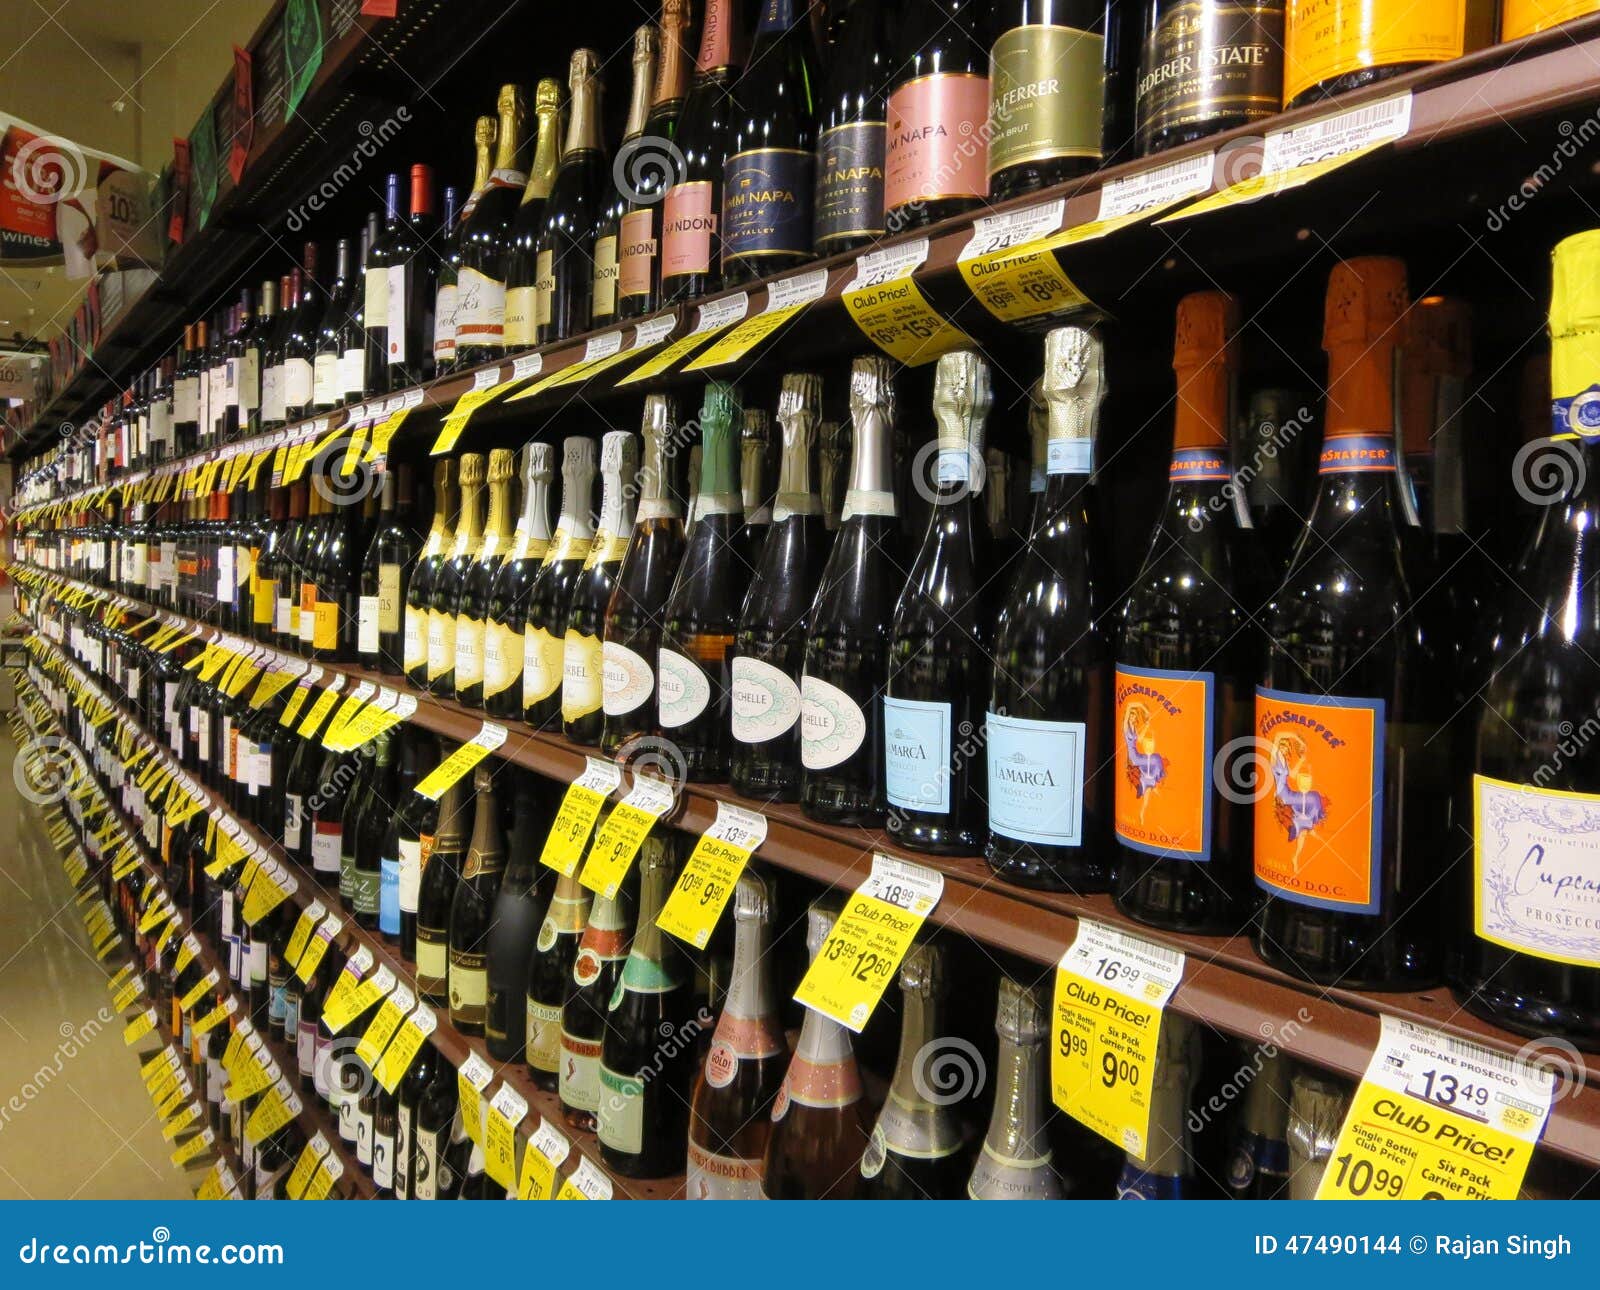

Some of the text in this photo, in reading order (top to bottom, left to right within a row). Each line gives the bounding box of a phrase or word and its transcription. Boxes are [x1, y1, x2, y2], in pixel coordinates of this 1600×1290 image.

[1002, 79, 1059, 107] FERRER
[900, 124, 947, 146] NAPA
[1006, 123, 1029, 137] BRUT
[1349, 132, 1370, 142] BRUT
[835, 167, 882, 181] NAPA
[749, 190, 795, 202] NAPA
[2, 231, 51, 247] wines
[853, 284, 911, 309] Club Price!
[1023, 280, 1063, 302] 1800
[902, 316, 941, 339] 1530
[616, 808, 631, 819] Club
[702, 842, 744, 864] Club Price!
[678, 871, 704, 892] 1099
[1305, 882, 1346, 897] D.O.C.
[700, 882, 725, 905] 990
[885, 884, 914, 906] 1899
[854, 903, 914, 932] Club Price!
[824, 936, 857, 961] 1399
[886, 937, 897, 946] Pack
[851, 950, 892, 982] 1260
[1095, 957, 1140, 982] 1699
[1136, 955, 1172, 973] PROSECCO
[1066, 981, 1151, 1029] Club Price!
[1061, 1014, 1091, 1034] Club Price
[1077, 1013, 1096, 1027] Bottle
[1060, 1028, 1088, 1057] 999
[1107, 1026, 1140, 1048] Six Pack
[1100, 1034, 1147, 1064] Carrier Price
[1102, 1051, 1140, 1088] 900
[1410, 1043, 1457, 1066] CUPCAKE
[1460, 1060, 1518, 1087] PROSECCO
[1422, 1069, 1489, 1106] 1349
[1352, 1124, 1419, 1159] Single Bottle
[1373, 1099, 1515, 1165] Club Price!
[1355, 1137, 1407, 1166] Club Price
[1336, 1152, 1404, 1198] 1099
[1421, 1168, 1463, 1192] Carrier
[1437, 1158, 1491, 1189] Six Pack
